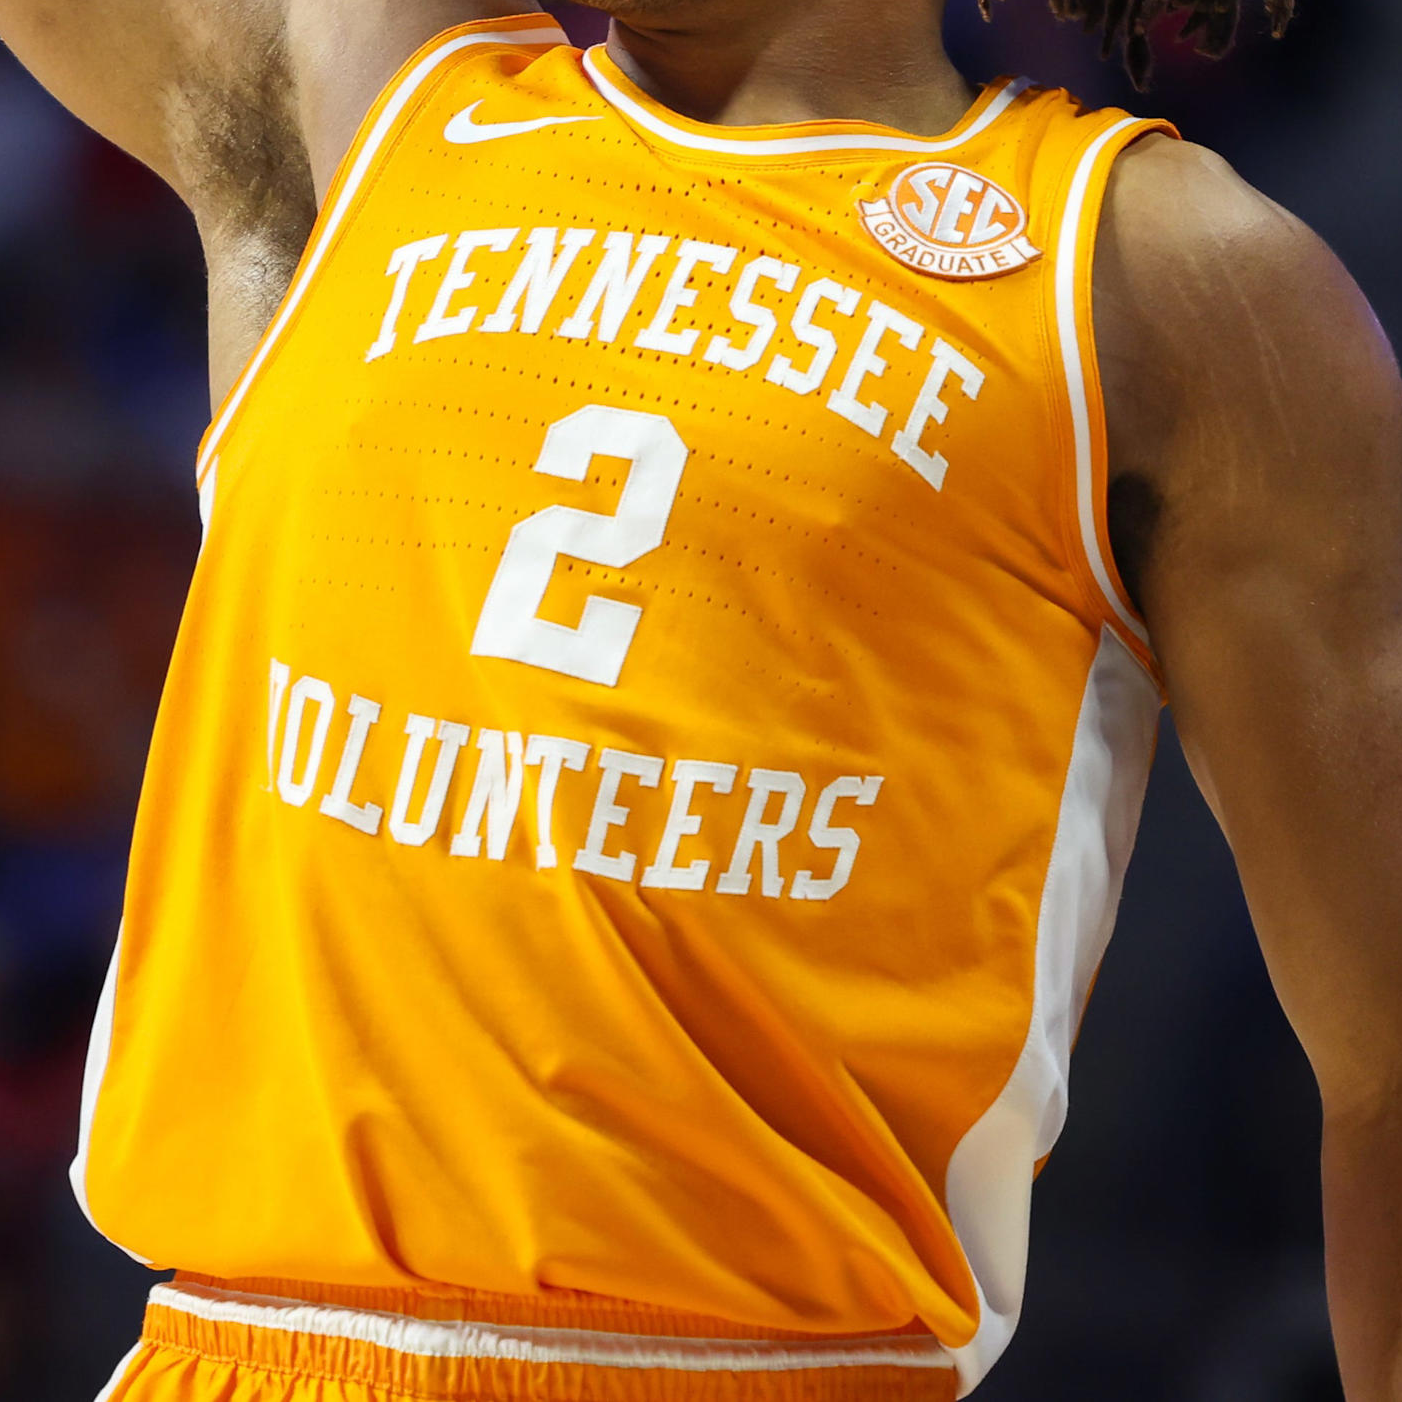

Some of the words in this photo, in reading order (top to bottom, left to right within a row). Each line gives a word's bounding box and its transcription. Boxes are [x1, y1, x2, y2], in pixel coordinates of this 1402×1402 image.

[874, 220, 1011, 274] GRADUATE
[901, 167, 1015, 245] SEC
[364, 226, 985, 491] TENNESSEE
[470, 404, 688, 687] 2
